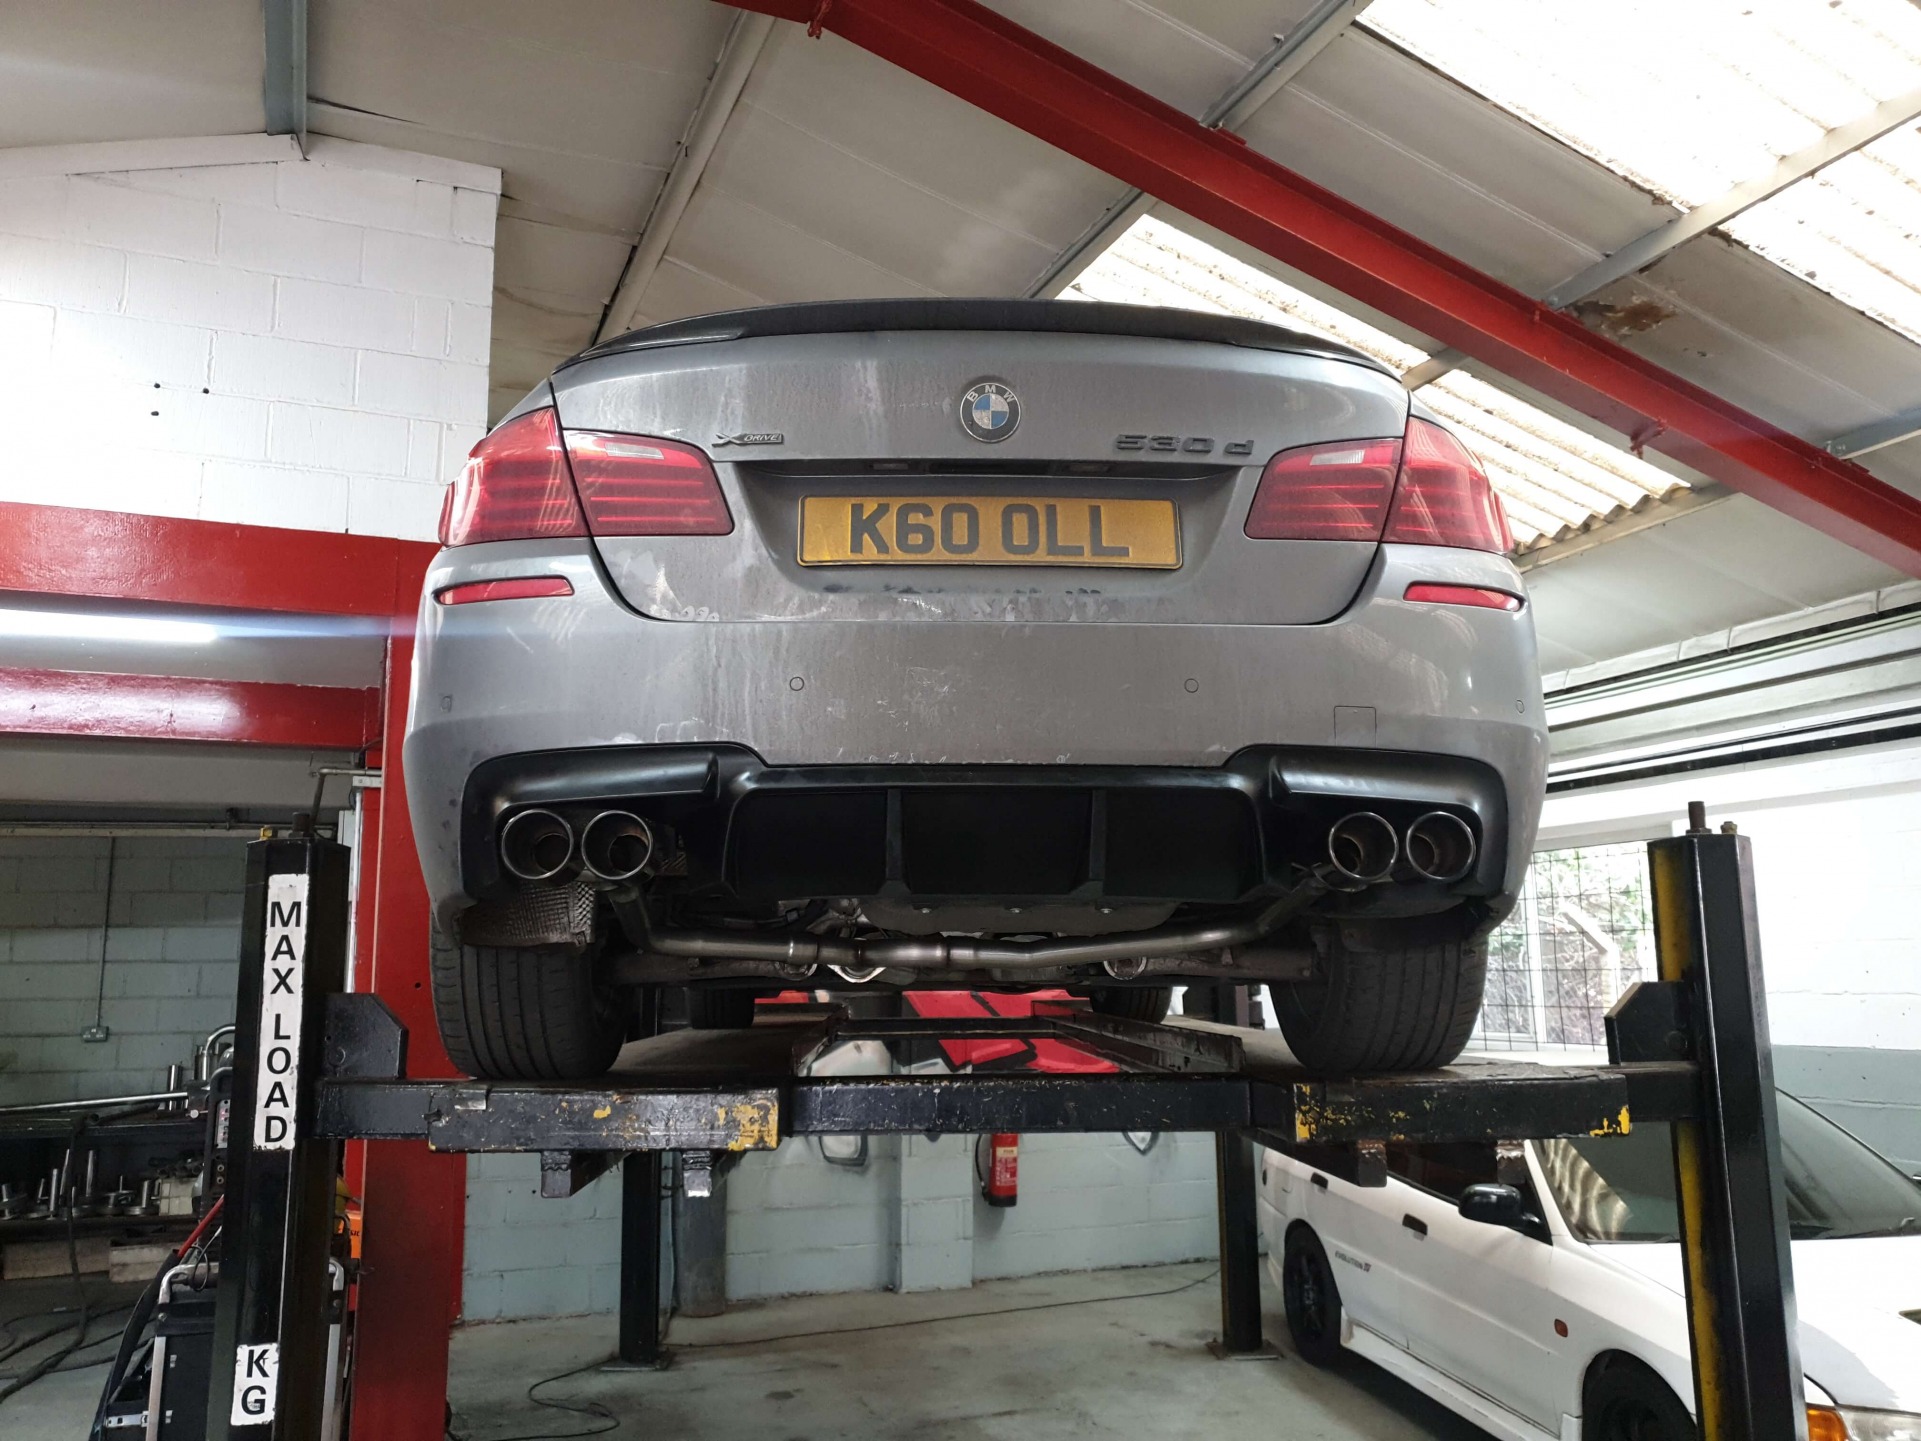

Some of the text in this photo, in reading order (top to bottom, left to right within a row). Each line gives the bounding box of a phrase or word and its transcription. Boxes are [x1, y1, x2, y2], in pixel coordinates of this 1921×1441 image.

[966, 384, 1017, 402] BMW
[850, 502, 980, 556] K60
[263, 901, 302, 1143] MAX LOAD
[241, 1349, 270, 1415] KG
